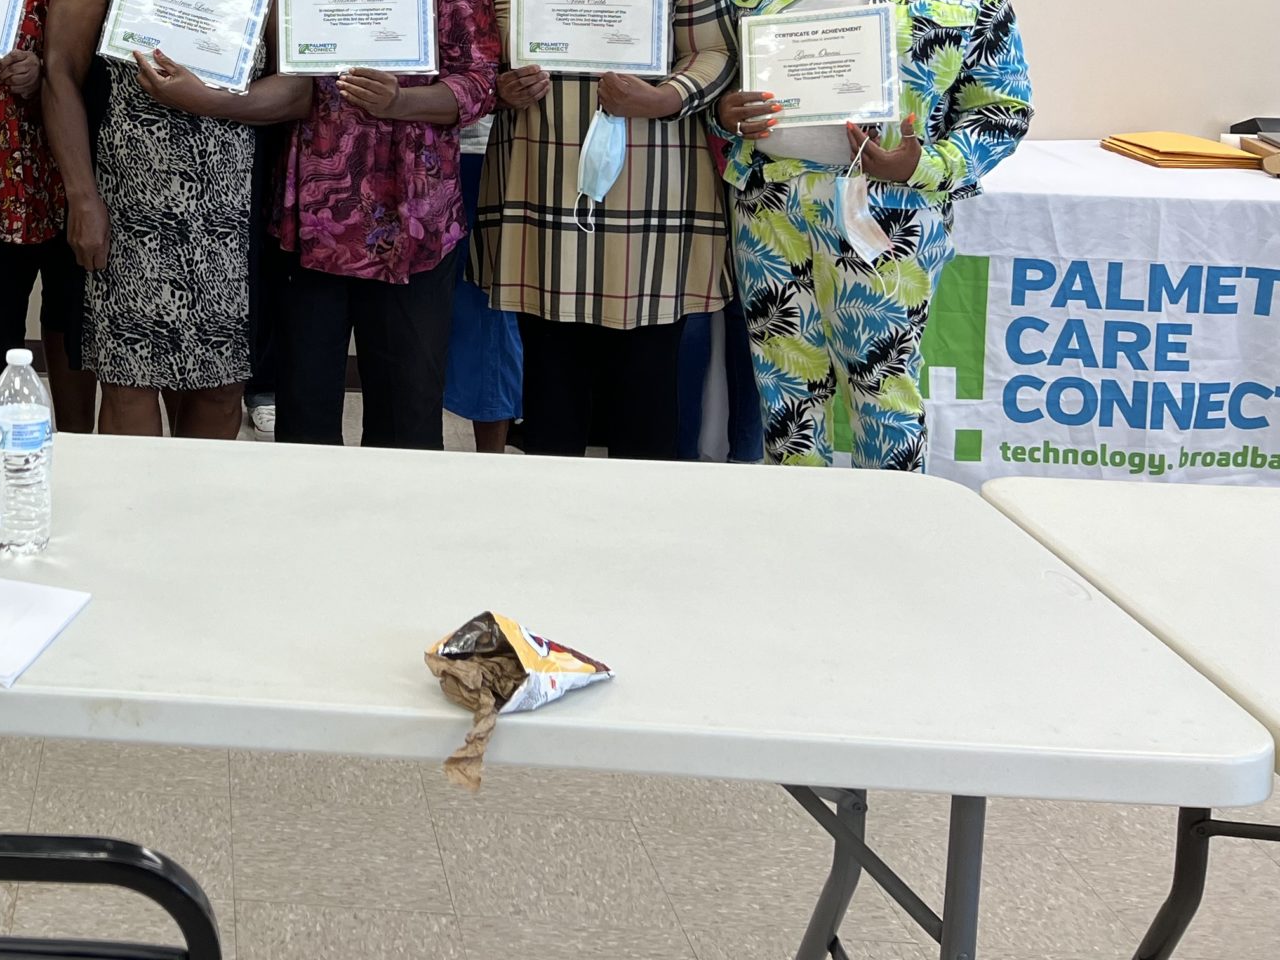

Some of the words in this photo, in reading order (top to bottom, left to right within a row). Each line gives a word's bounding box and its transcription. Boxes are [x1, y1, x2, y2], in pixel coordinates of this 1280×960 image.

[774, 30, 809, 38] CERTIFICATE
[821, 24, 861, 33] ACHIEVEMENT
[1005, 316, 1193, 371] CARE
[1002, 375, 1280, 430] CONNEC
